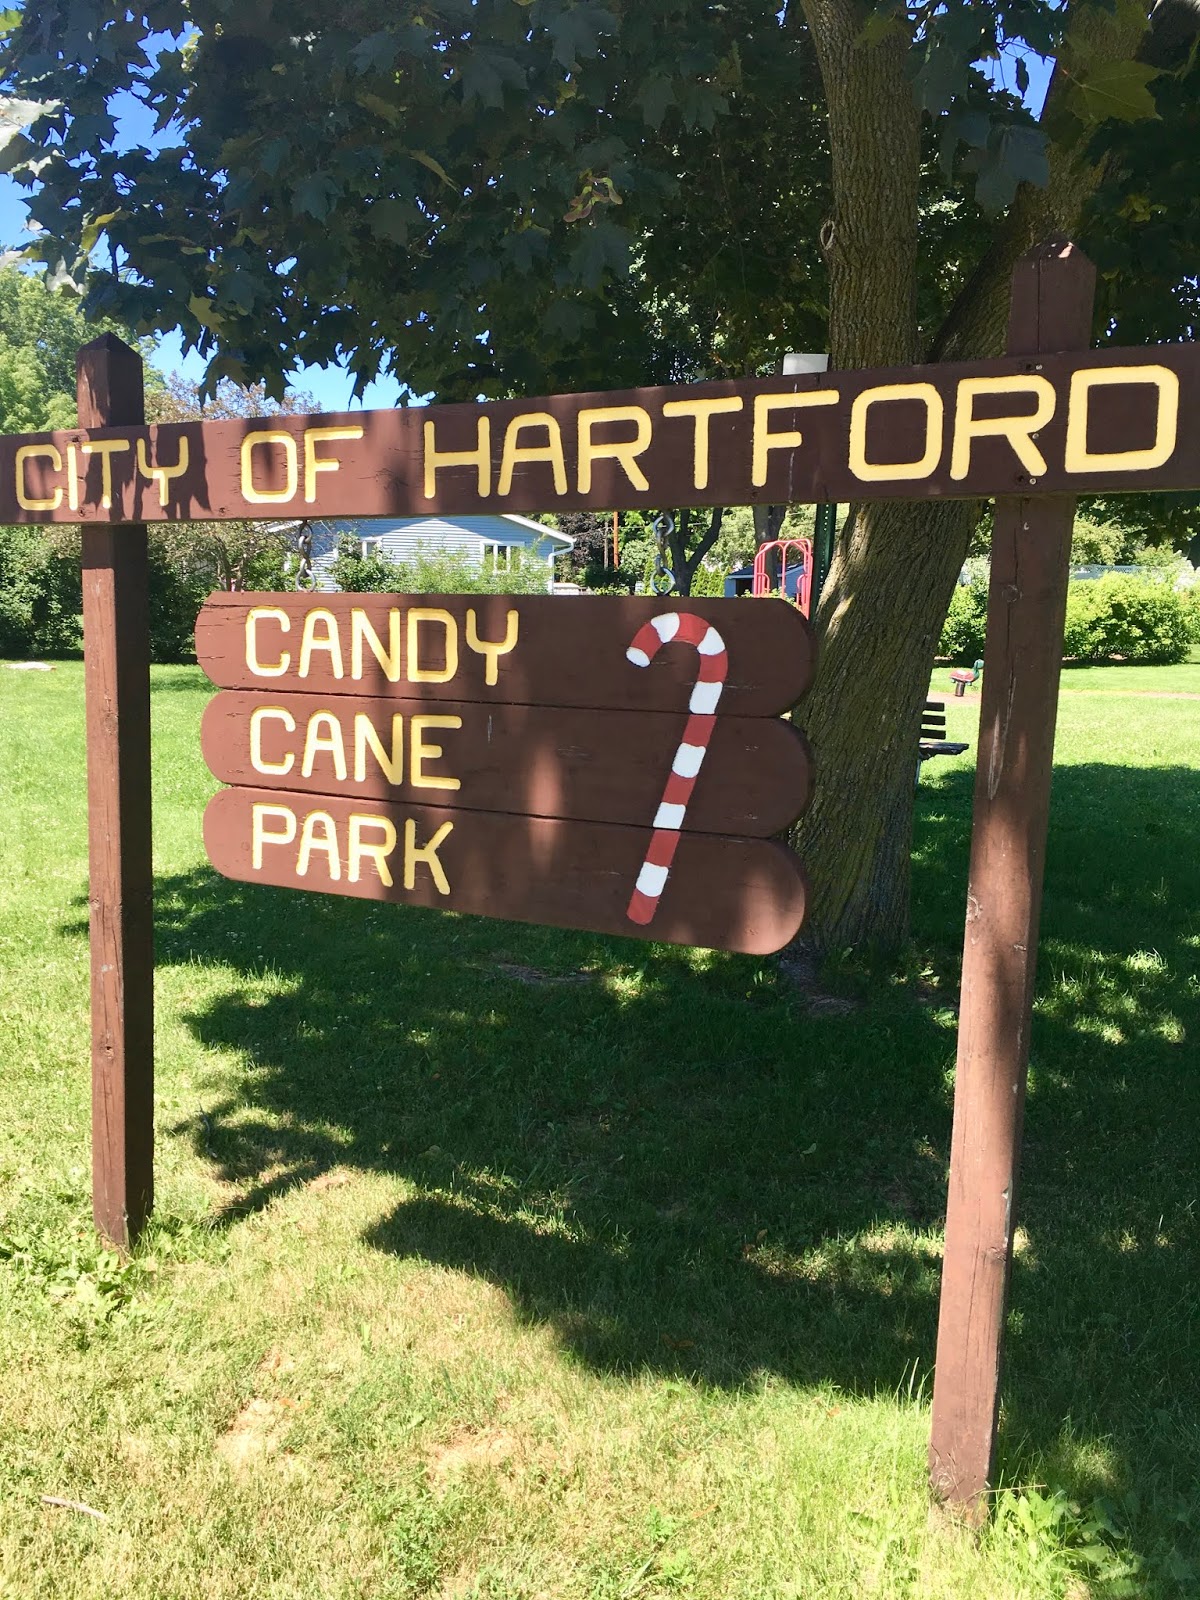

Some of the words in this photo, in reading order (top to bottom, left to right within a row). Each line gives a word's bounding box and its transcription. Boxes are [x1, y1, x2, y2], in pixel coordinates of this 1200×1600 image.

[15, 435, 190, 511] CITY
[241, 425, 364, 504] OF
[423, 364, 1179, 499] HARTFORD
[245, 606, 519, 686] CANDY
[250, 706, 463, 790] CANE
[252, 803, 454, 895] PARK
